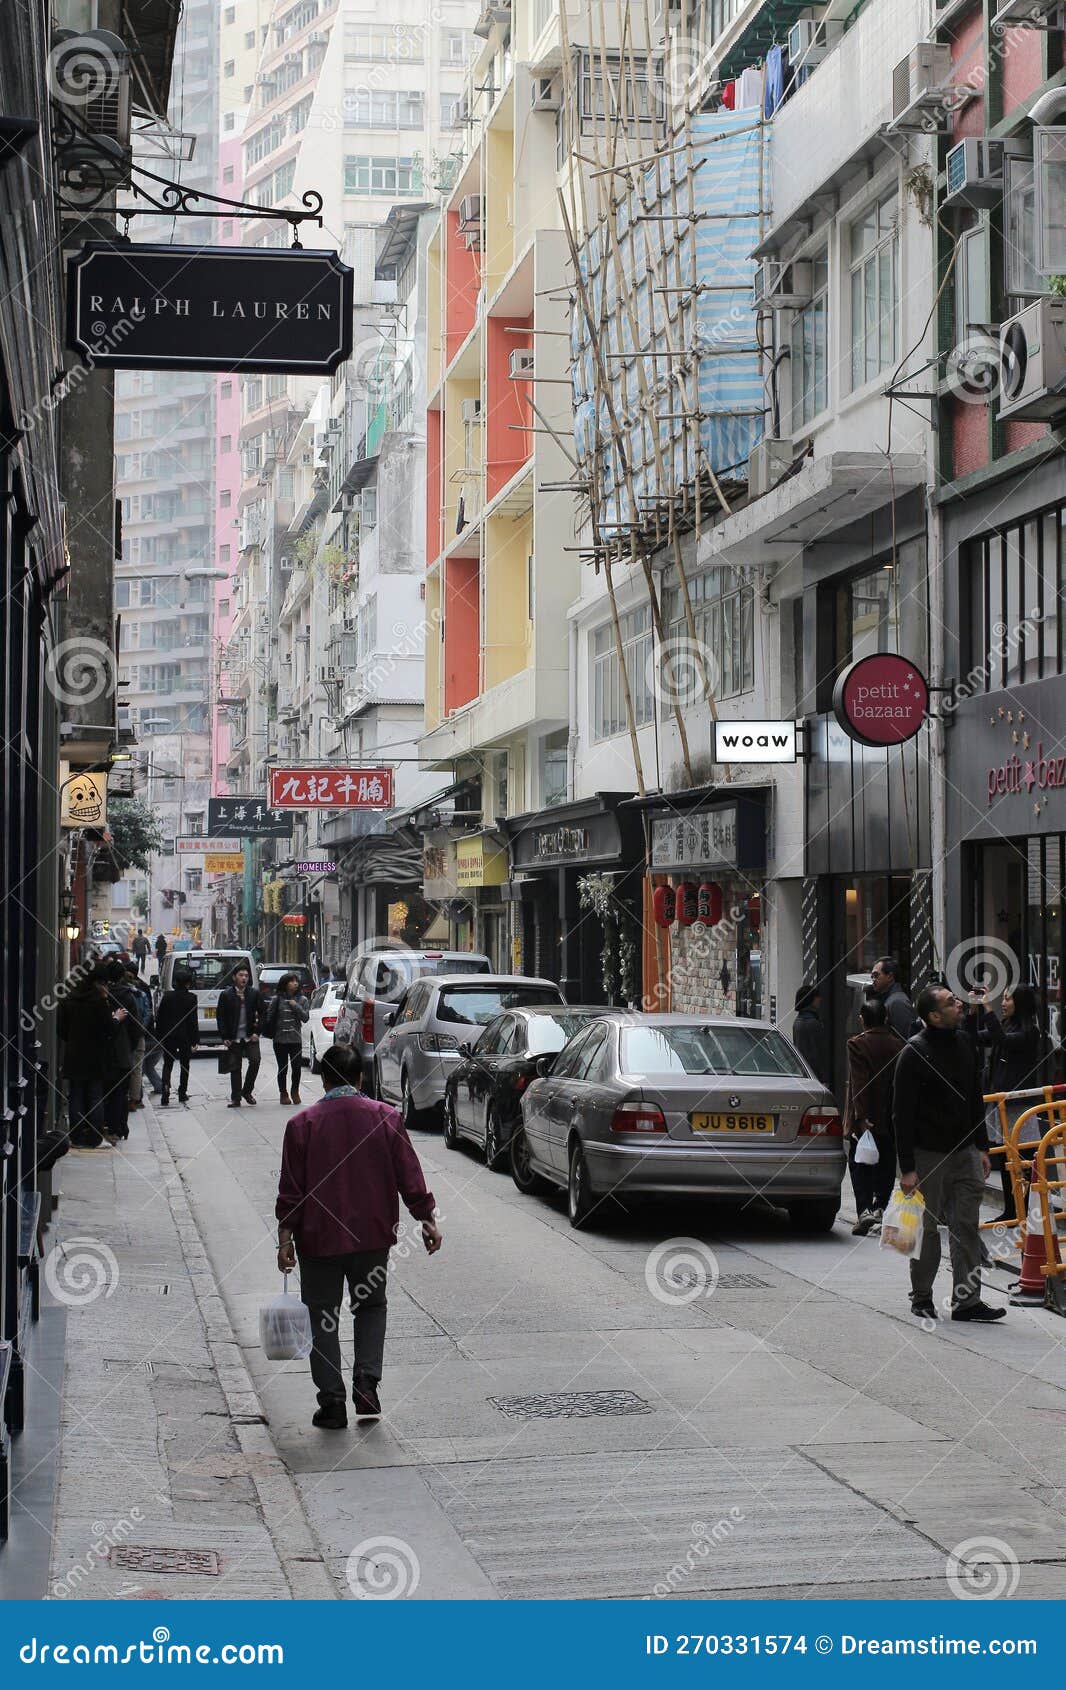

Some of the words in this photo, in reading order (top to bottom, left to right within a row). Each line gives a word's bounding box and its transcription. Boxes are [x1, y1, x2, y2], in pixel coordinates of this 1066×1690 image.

[89, 295, 191, 316] RALPH
[212, 300, 332, 320] LAUREN
[858, 682, 899, 703] petit
[852, 699, 912, 718] bazaar
[722, 735, 788, 748] woaw
[279, 774, 384, 803] 九記牛腩
[987, 753, 1023, 806] petit
[297, 862, 336, 873] HOMELESS
[700, 1115, 721, 1129] JU
[726, 1116, 767, 1130] 9616
